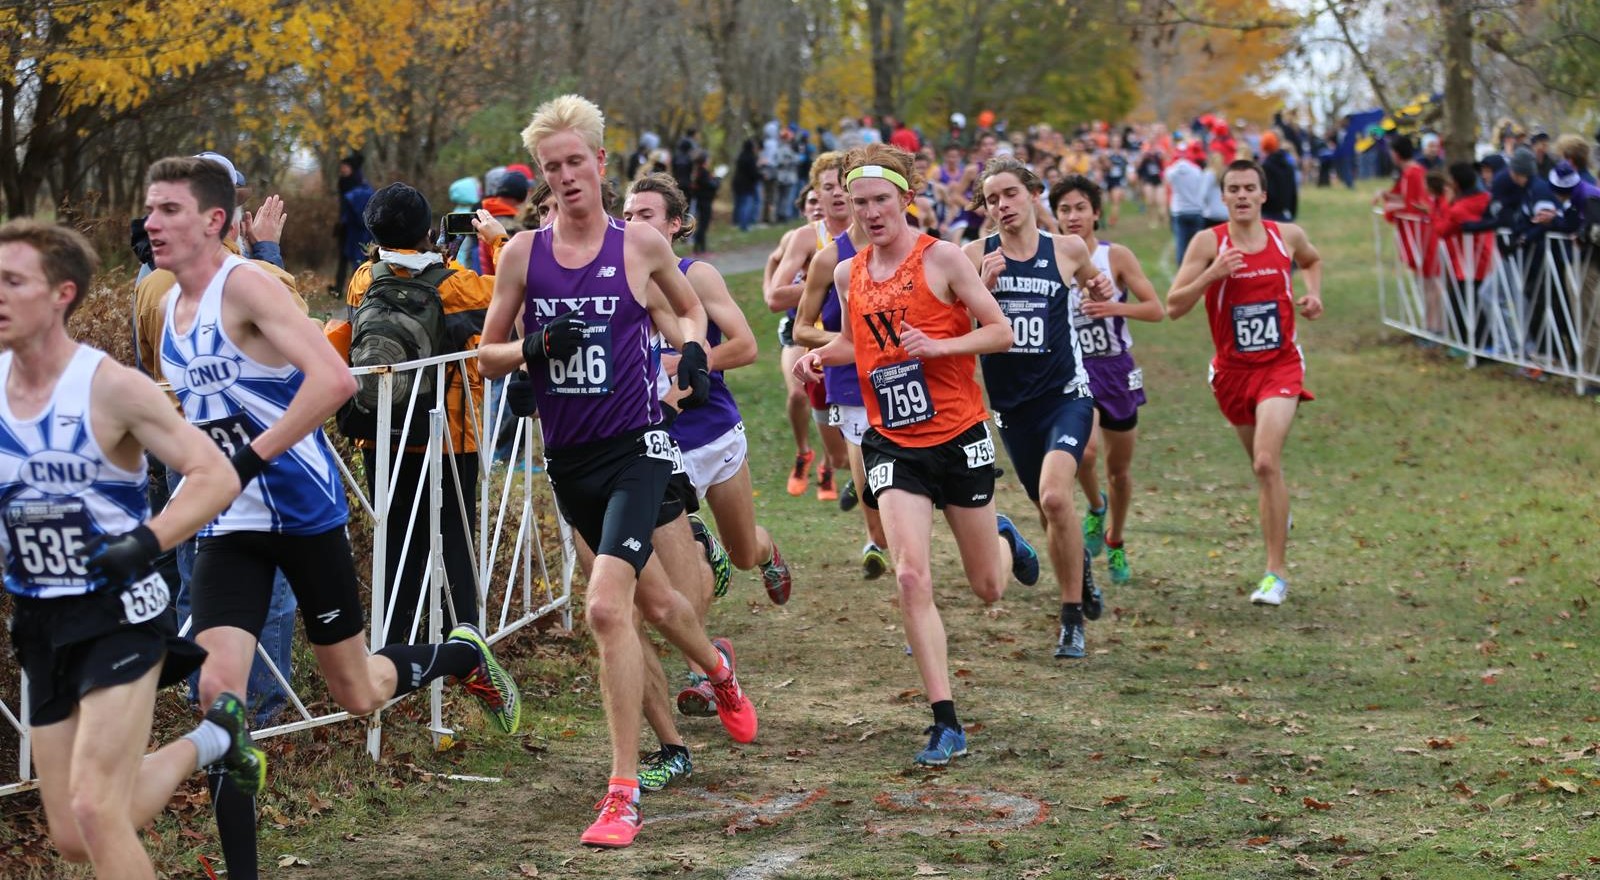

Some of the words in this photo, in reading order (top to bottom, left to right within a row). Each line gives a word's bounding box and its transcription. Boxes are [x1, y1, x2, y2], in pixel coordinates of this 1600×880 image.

[991, 275, 1061, 297] DDLEBURY
[533, 296, 620, 317] NYU
[863, 307, 908, 351] W
[1079, 325, 1109, 354] 93
[1236, 316, 1280, 347] 524
[188, 361, 232, 388] CNU
[549, 344, 607, 385] 646
[879, 380, 928, 421] 759
[209, 422, 252, 458] 31
[29, 461, 87, 483] CNU
[15, 526, 89, 576] 535
